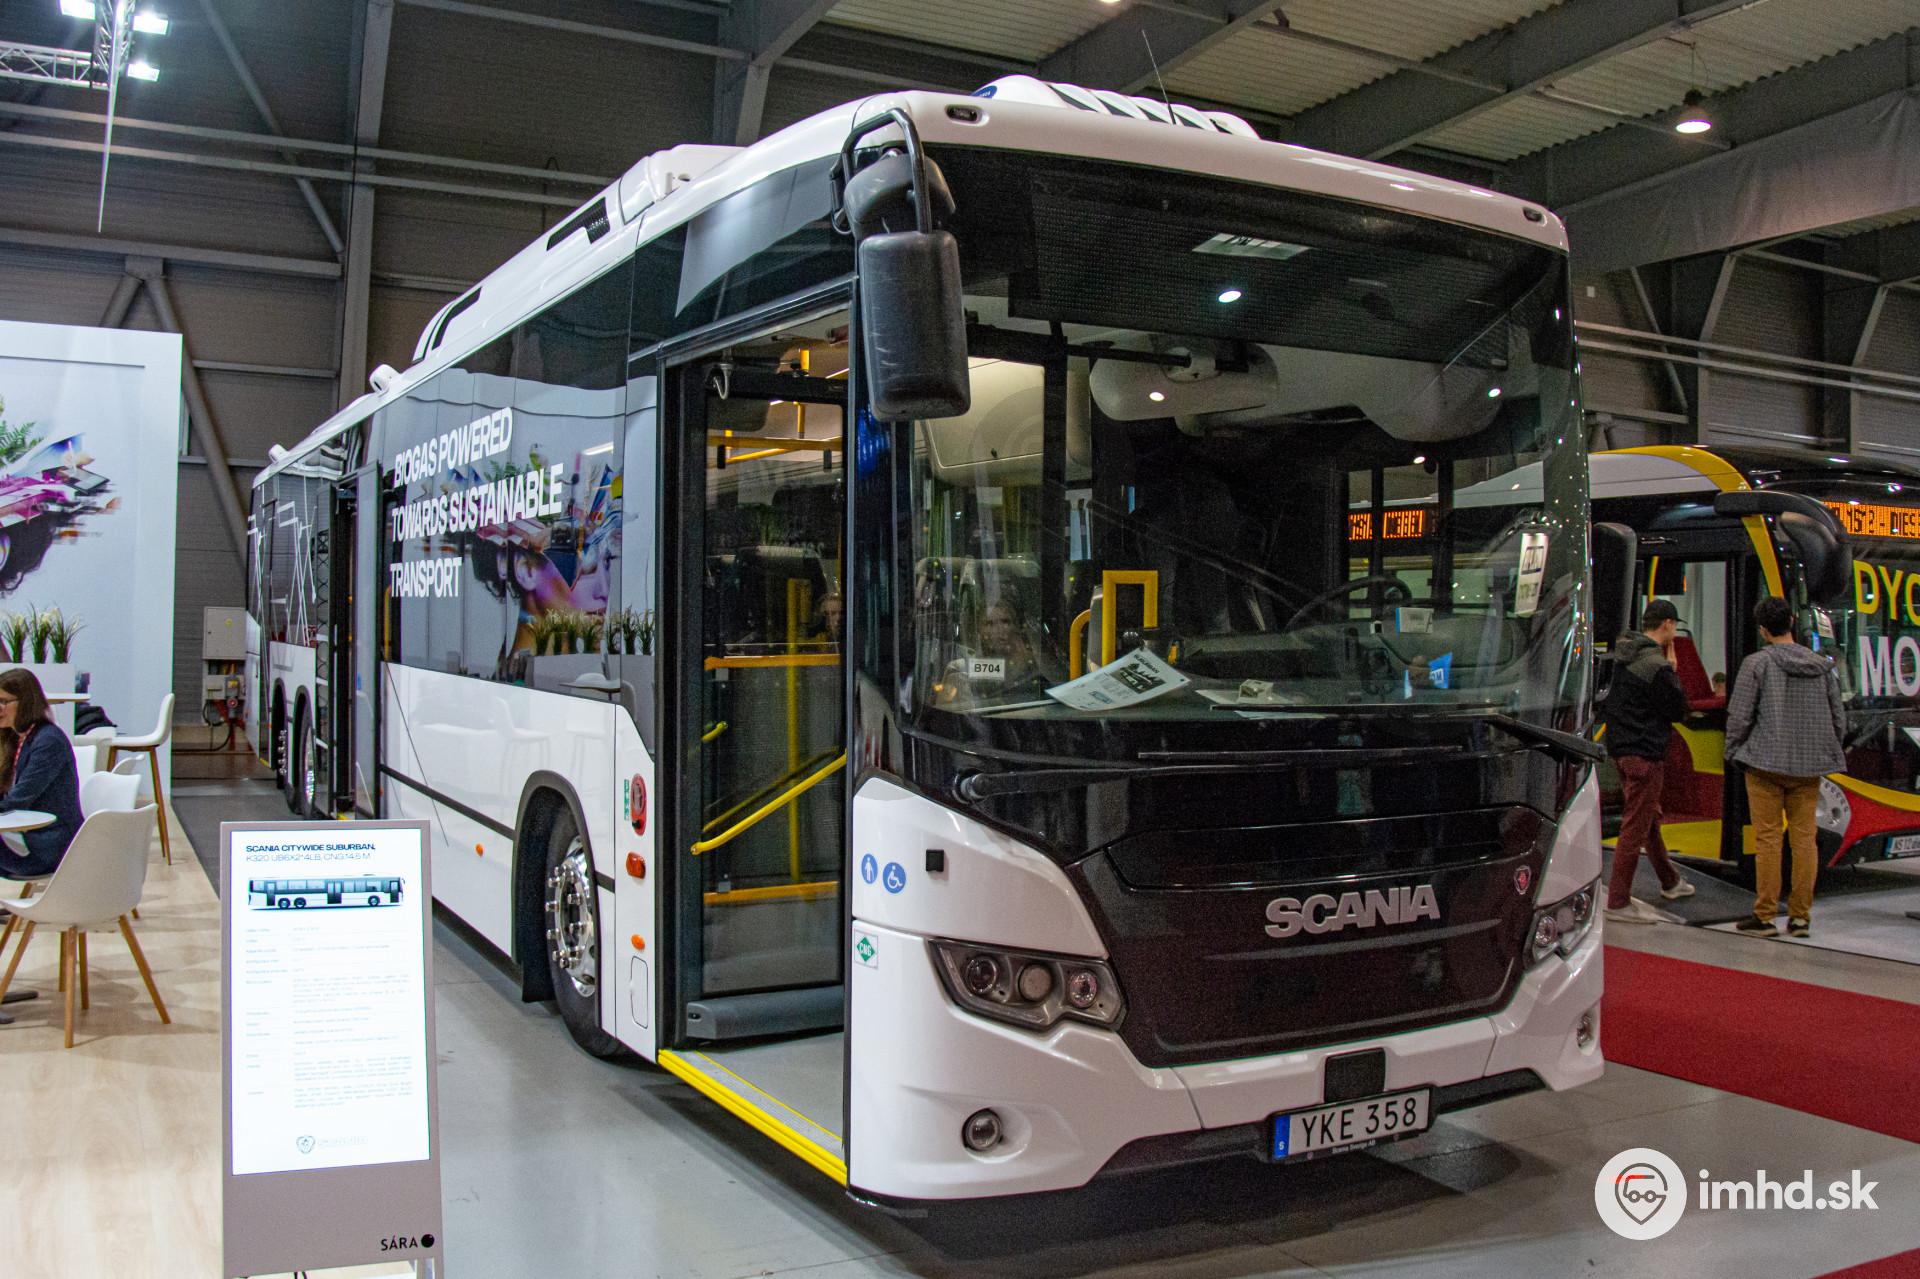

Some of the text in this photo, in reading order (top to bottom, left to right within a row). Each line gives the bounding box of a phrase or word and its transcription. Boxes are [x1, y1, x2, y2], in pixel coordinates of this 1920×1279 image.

[393, 407, 513, 488] BIOGAS POWERED
[391, 463, 564, 542] TOWARDS SUSTAINABLE
[390, 556, 463, 598] TRANSPORT
[974, 663, 1001, 673] B704
[1264, 884, 1441, 938] SCANIA
[859, 942, 873, 957] CNG
[1301, 1097, 1418, 1148] YKE 358
[380, 1234, 419, 1252] SÁRA
